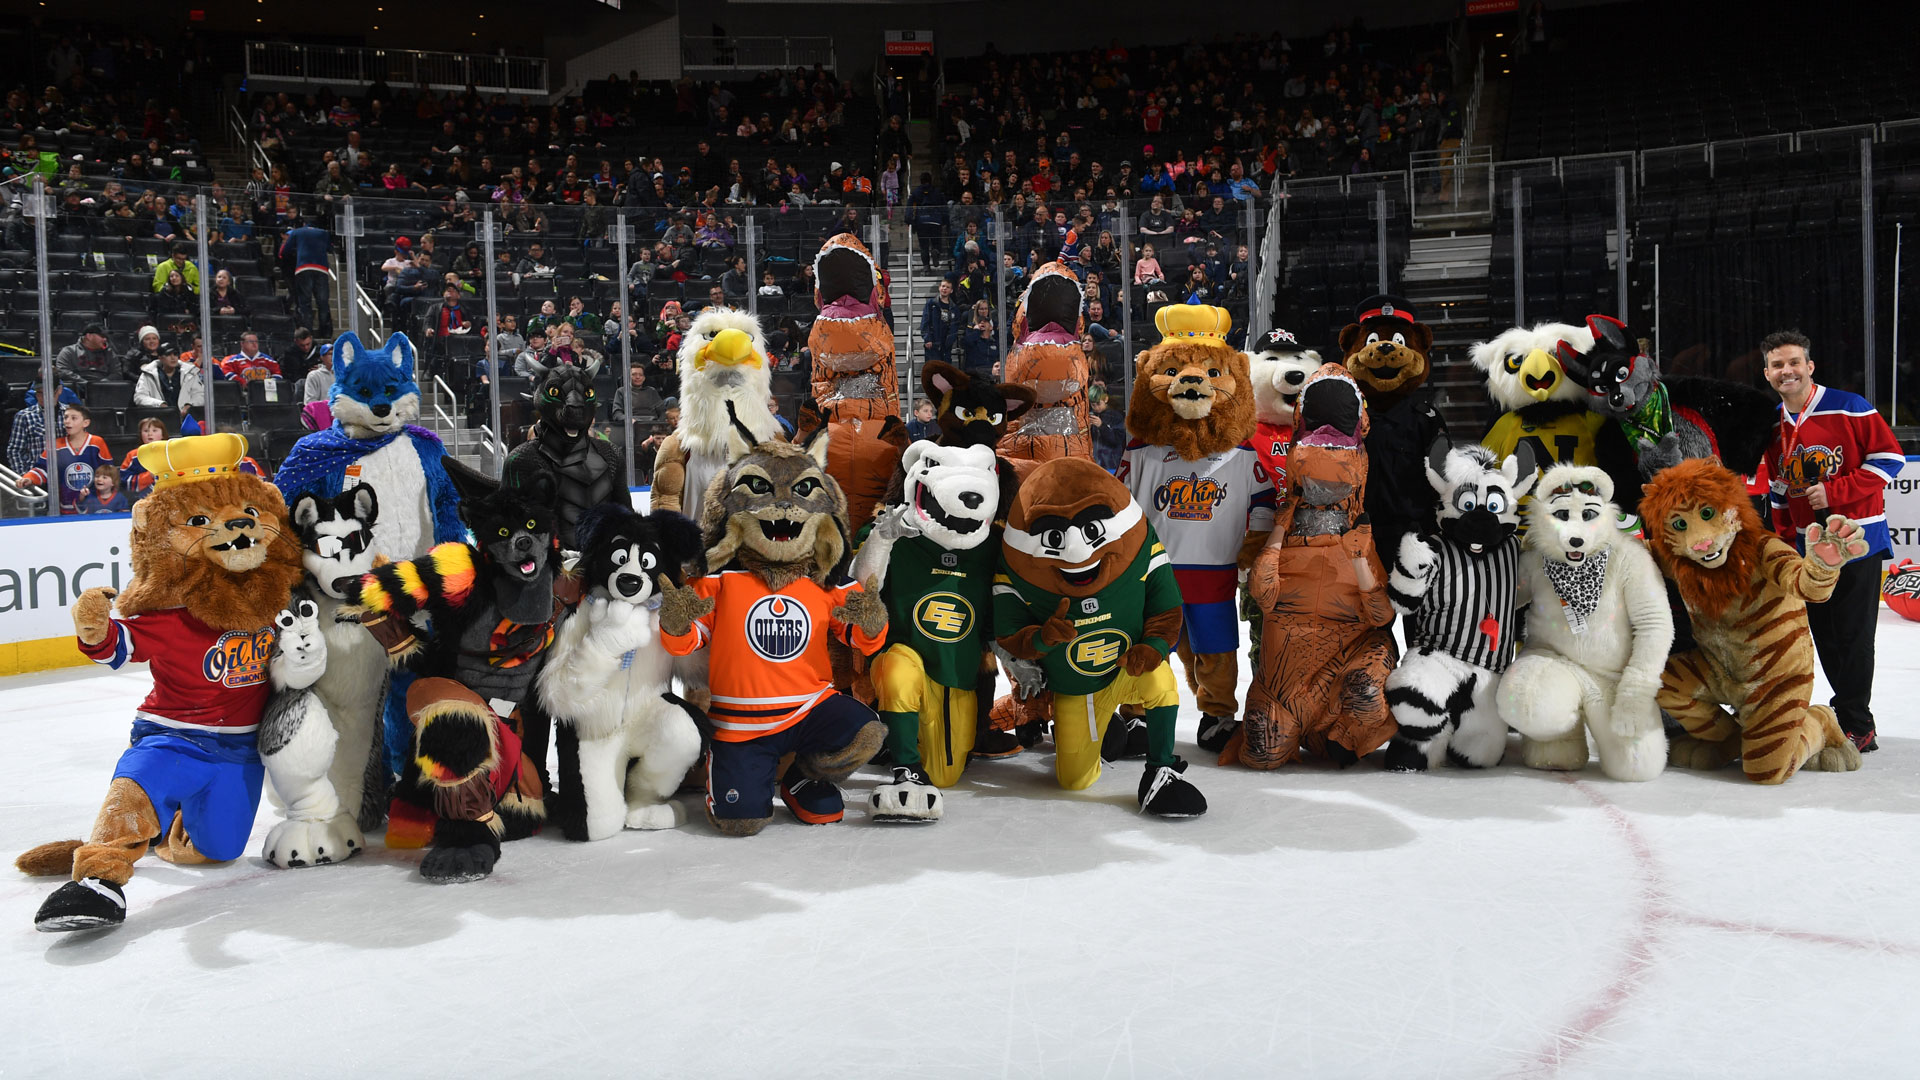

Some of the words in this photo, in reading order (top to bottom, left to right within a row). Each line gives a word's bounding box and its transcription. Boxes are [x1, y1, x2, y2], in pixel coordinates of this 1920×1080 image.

[67, 472, 91, 489] OILERS
[1153, 484, 1190, 511] Oil
[1191, 479, 1228, 507] Kings
[1170, 511, 1210, 519] EDMONTON
[943, 556, 956, 564] CFL
[0, 546, 133, 613] anci
[1084, 602, 1097, 611] CFL
[1074, 612, 1113, 628] ESKIMOS
[755, 618, 802, 656] OILERS
[203, 641, 250, 681] Oil
[228, 671, 267, 685] EDMONT
